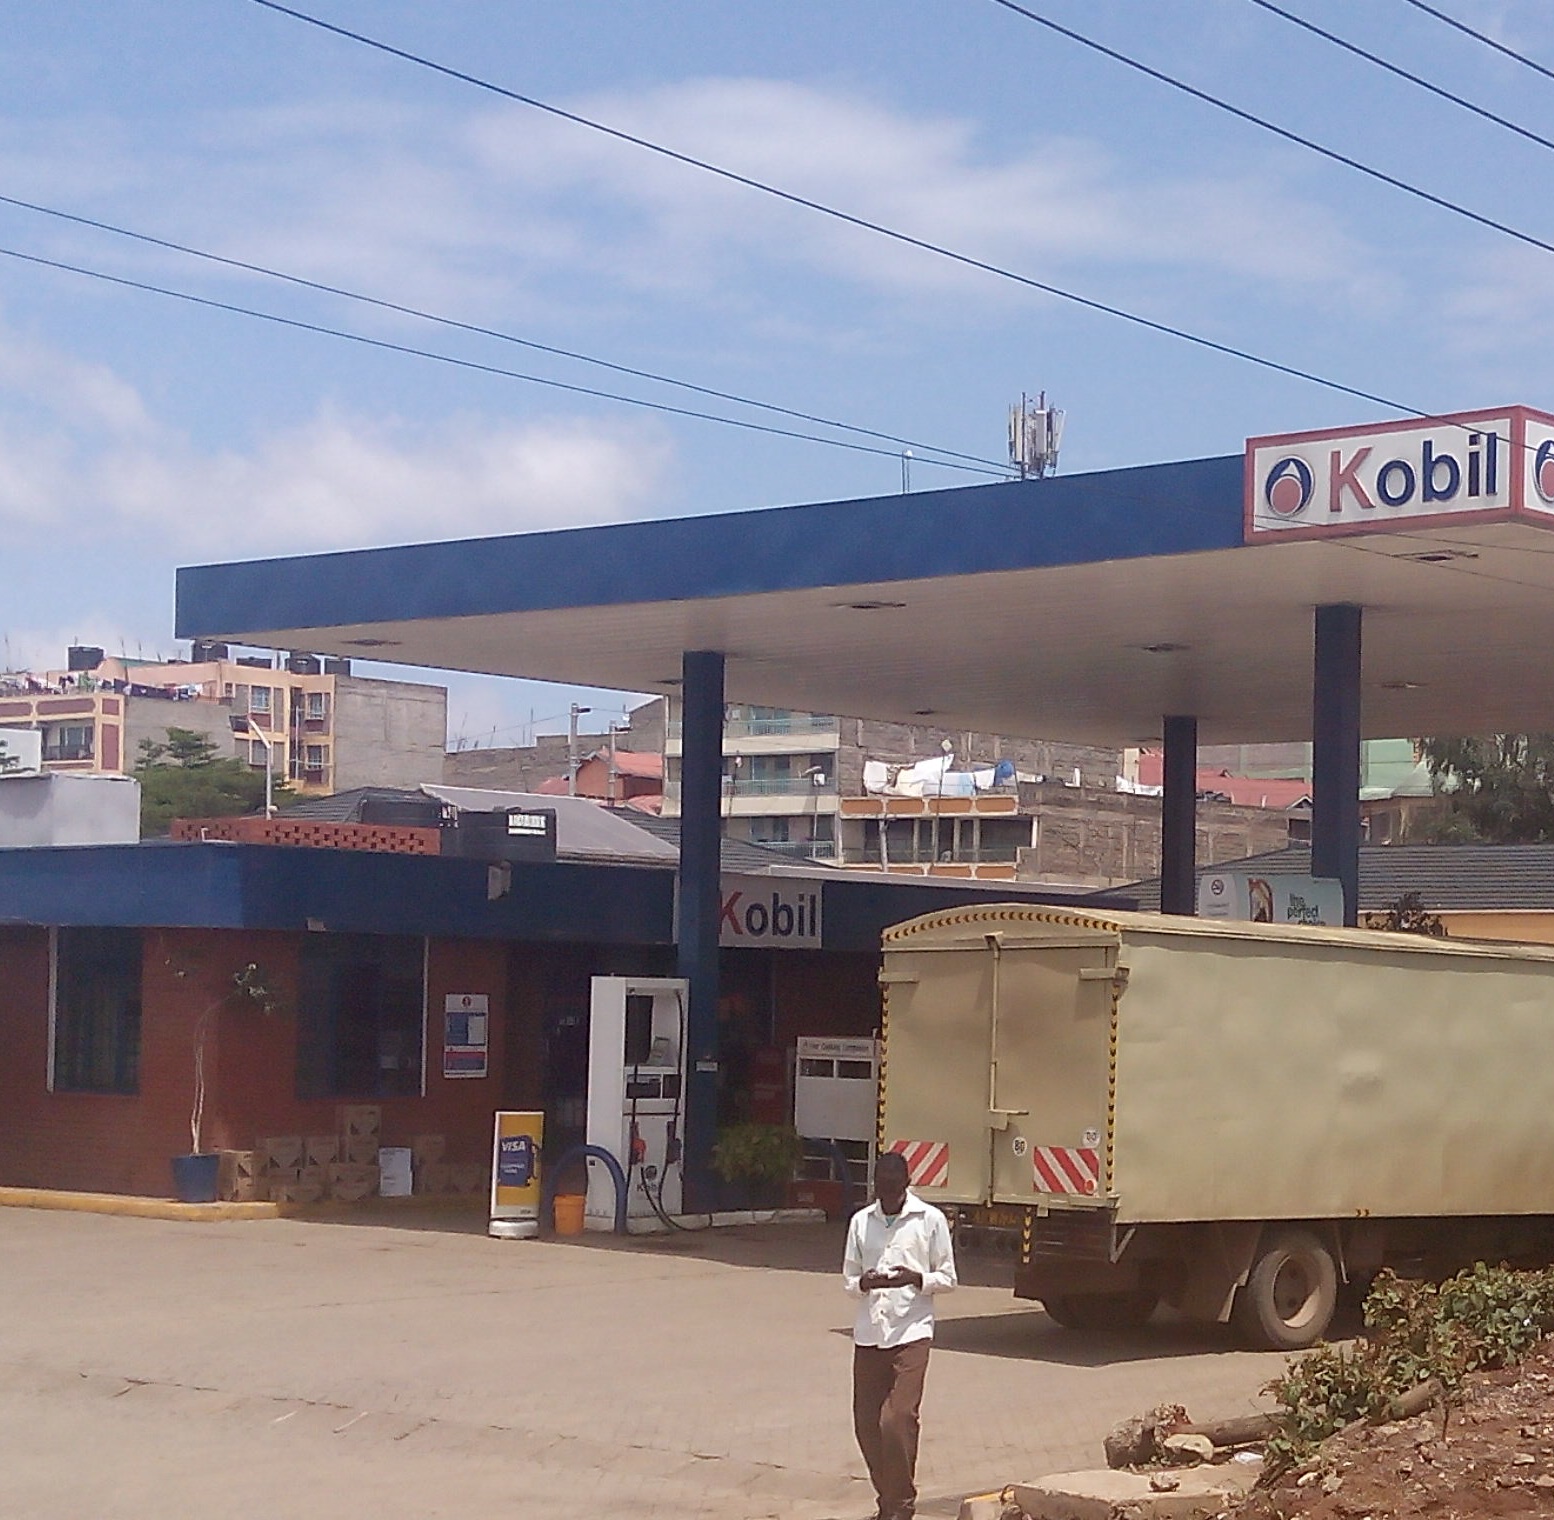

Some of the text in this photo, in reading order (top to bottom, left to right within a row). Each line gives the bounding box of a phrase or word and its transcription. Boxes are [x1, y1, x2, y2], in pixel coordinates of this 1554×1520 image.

[1329, 432, 1498, 513] Kobil
[719, 891, 817, 938] Kobil
[501, 1140, 526, 1152] VISA
